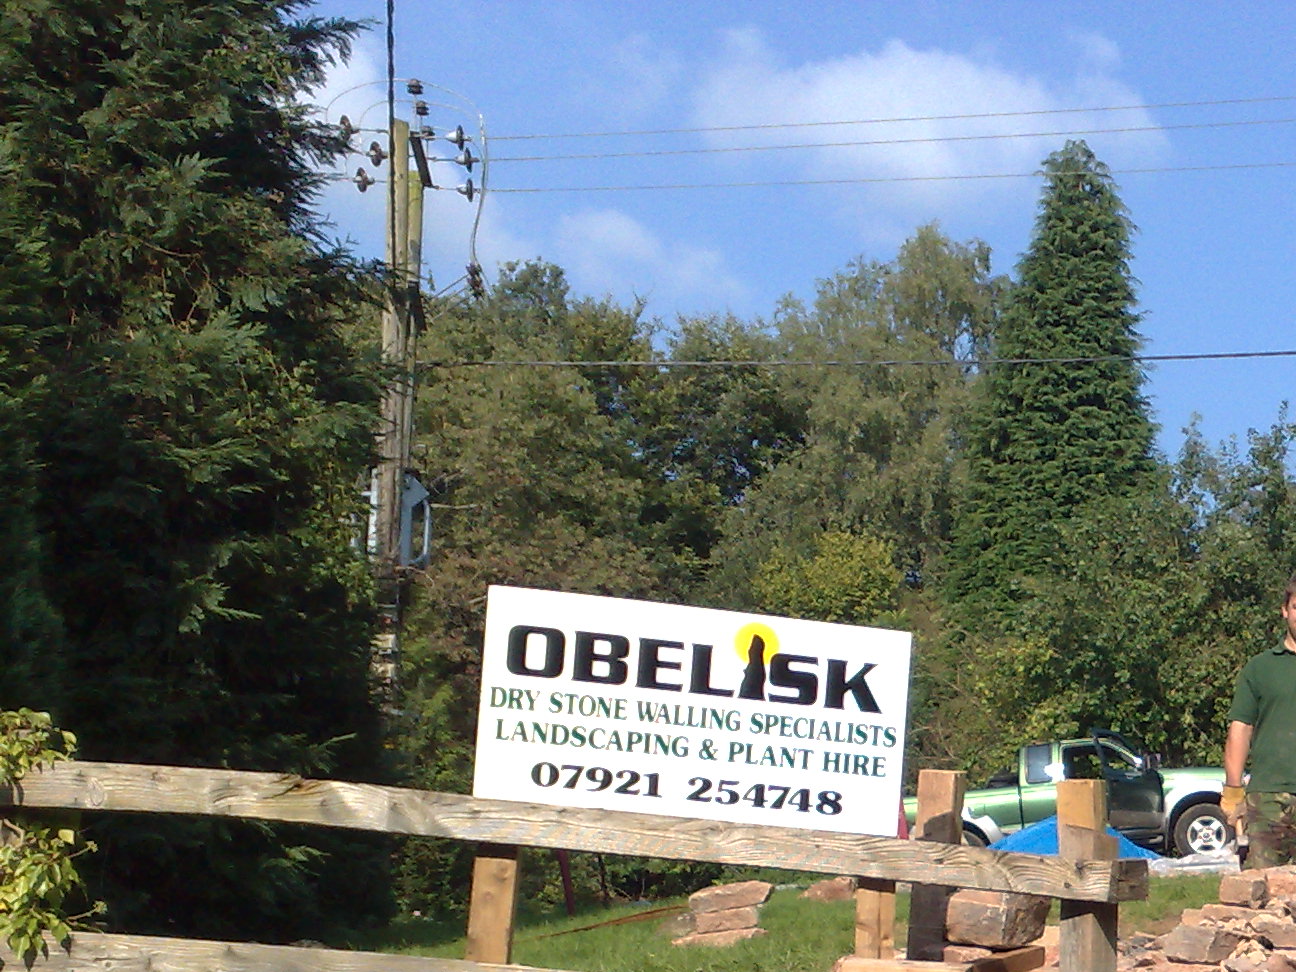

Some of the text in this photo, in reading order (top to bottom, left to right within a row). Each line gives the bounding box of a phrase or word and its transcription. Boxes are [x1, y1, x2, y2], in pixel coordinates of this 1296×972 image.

[507, 626, 880, 713] OBELISK
[490, 687, 896, 747] DRY STONE WALLING SPECIALISTS
[496, 719, 886, 777] LANDSCAPING & PLANT HIRE
[531, 762, 842, 815] 07921 254748
